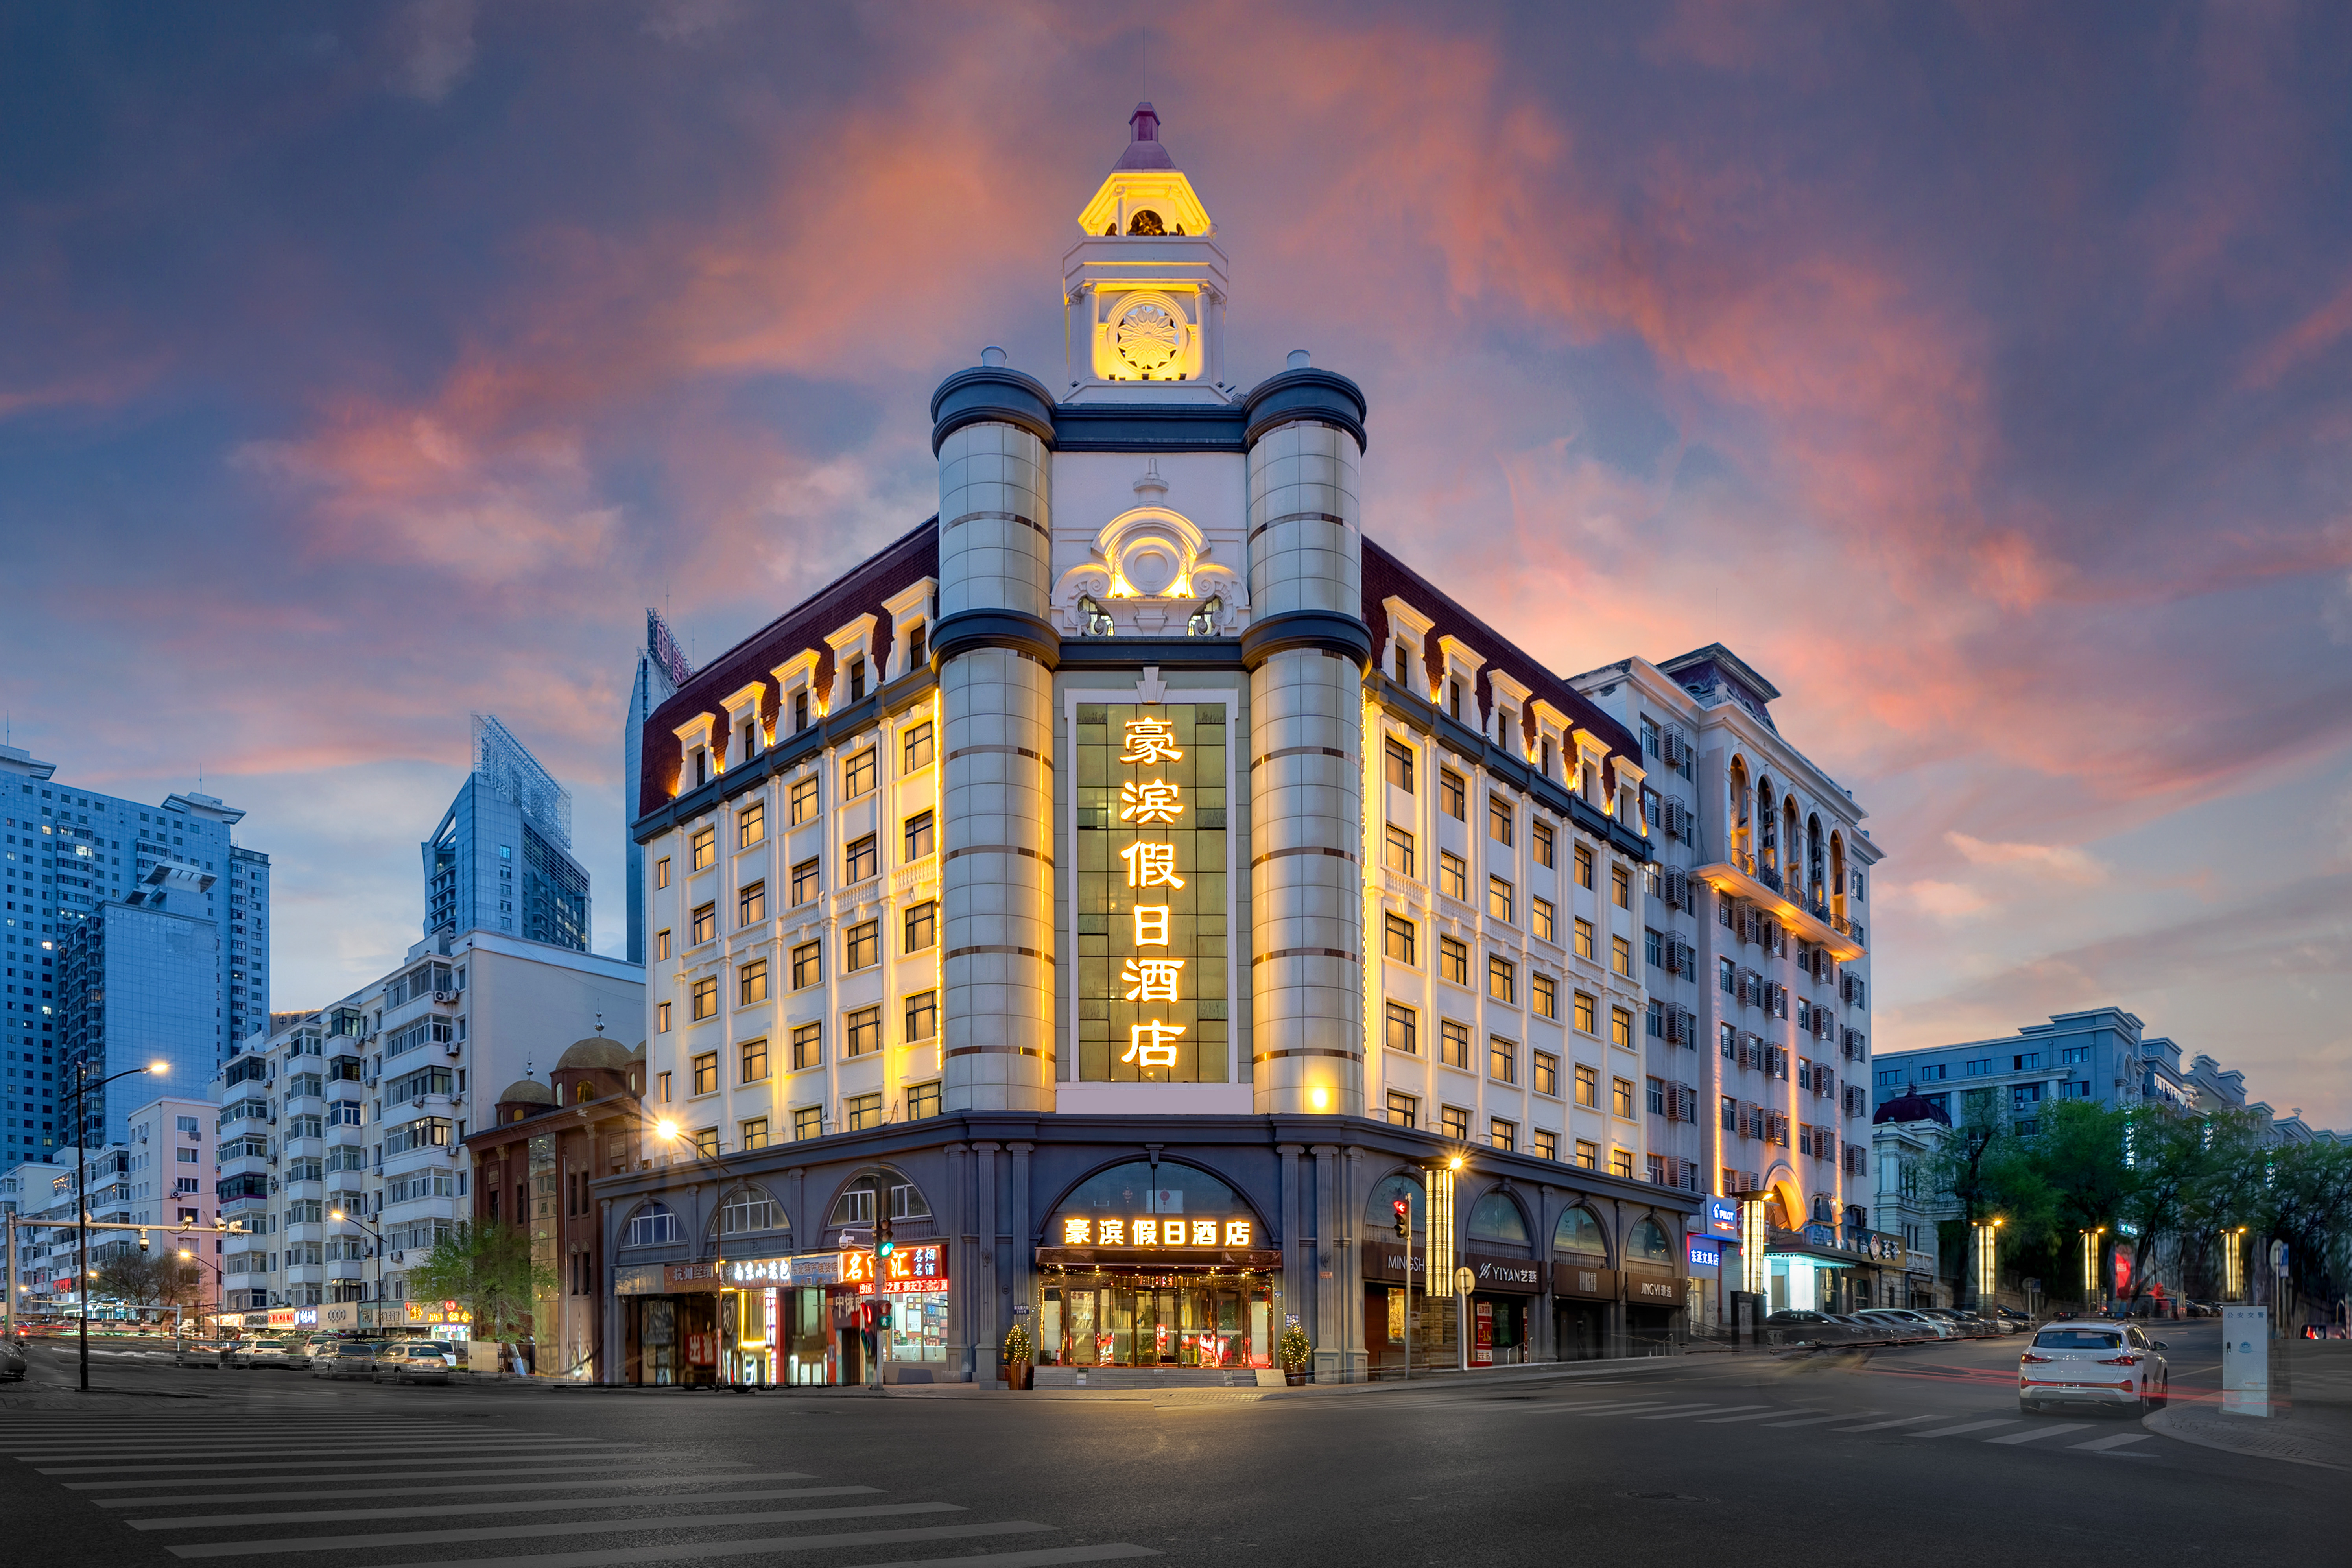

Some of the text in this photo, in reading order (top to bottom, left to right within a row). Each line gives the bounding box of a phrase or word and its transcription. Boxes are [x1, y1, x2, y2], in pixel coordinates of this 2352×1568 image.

[657, 622, 691, 684] 中国
[1120, 716, 1186, 1068] 豪滨假日酒店
[279, 1014, 312, 1026] 中国
[1719, 1210, 1734, 1221] PILOT
[1065, 1219, 1250, 1246] 豪滨假日酒店
[913, 1248, 936, 1263] 名烟
[1691, 1250, 1719, 1266] 东丞文具店
[673, 1265, 714, 1281] 杭州丝绸
[792, 1261, 838, 1276] 东北特产俄货店
[913, 1263, 935, 1276] 名酒
